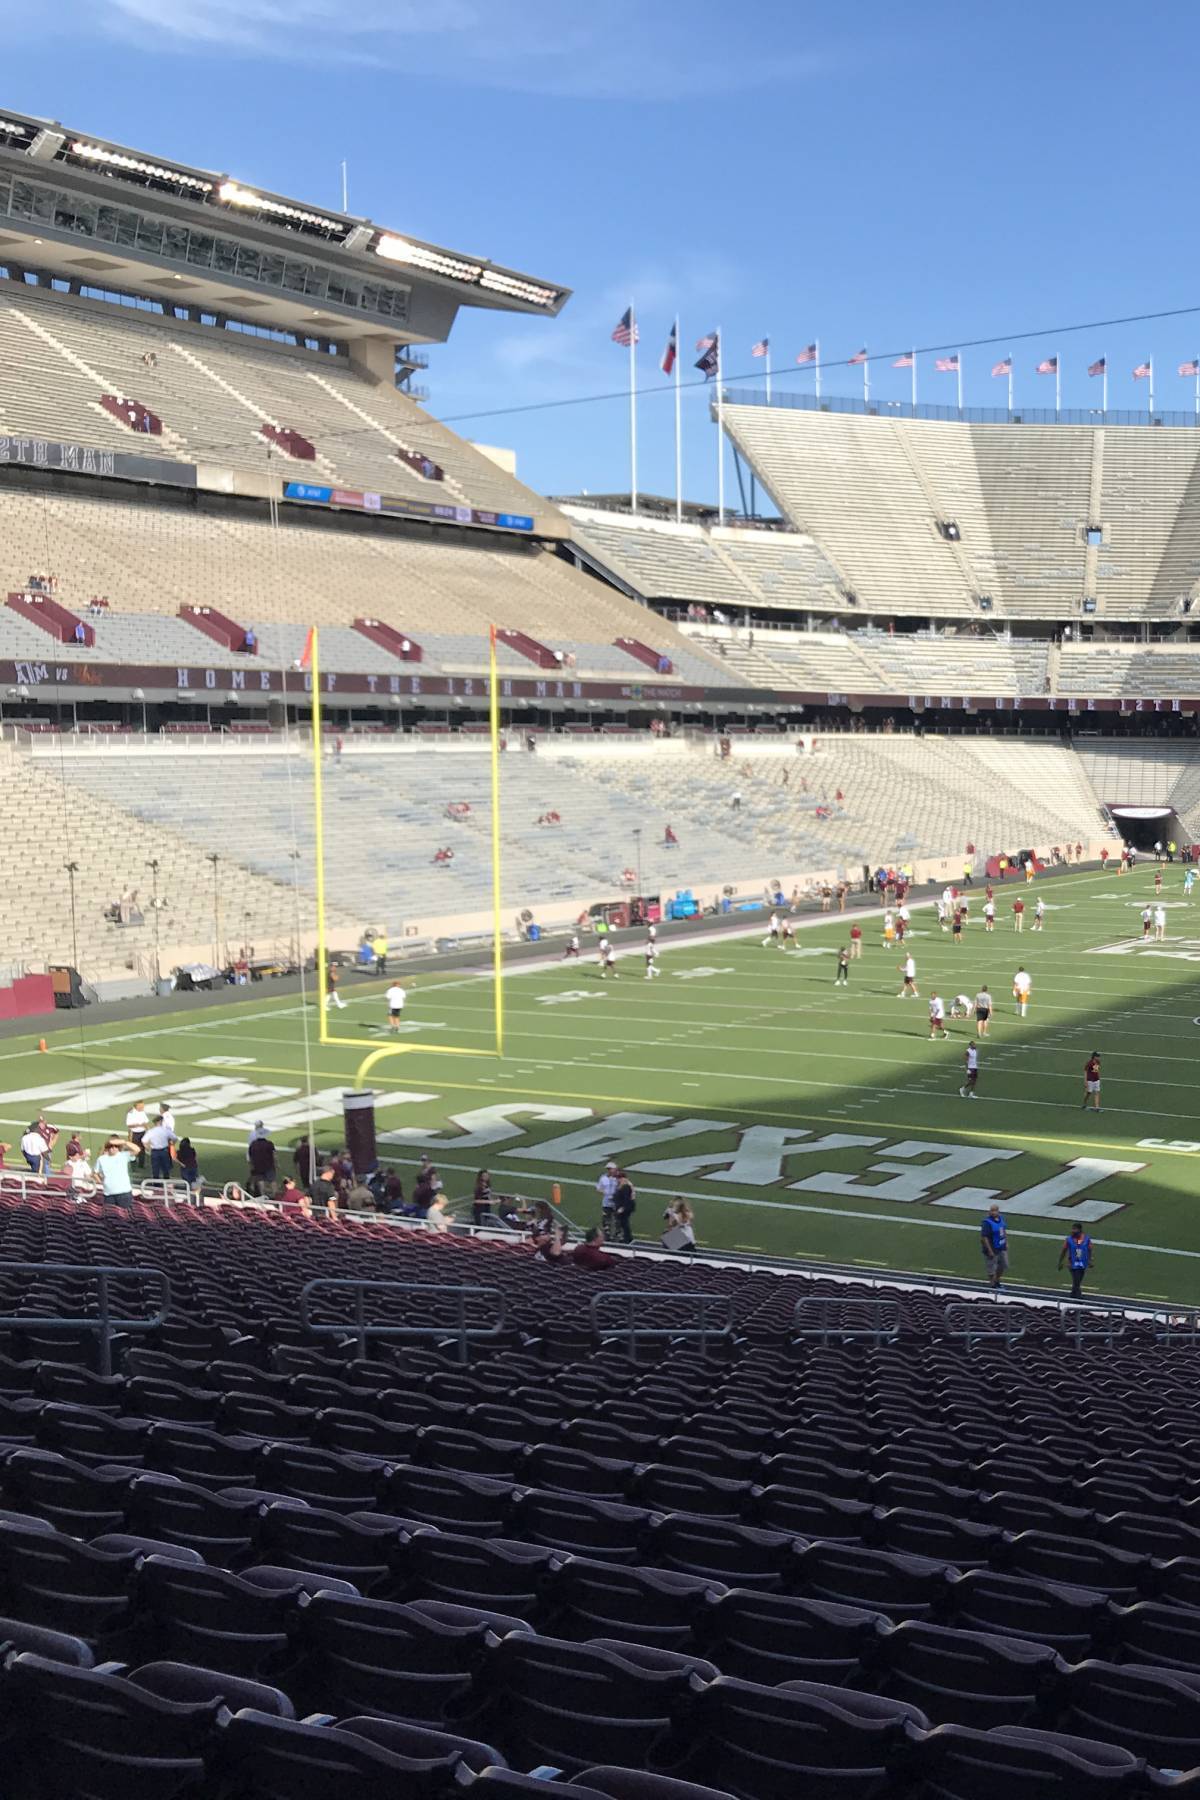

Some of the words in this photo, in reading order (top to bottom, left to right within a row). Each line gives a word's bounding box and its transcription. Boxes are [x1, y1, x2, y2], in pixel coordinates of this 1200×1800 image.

[60, 443, 114, 474] MAN
[177, 668, 271, 690] HOME
[367, 676, 420, 693] THE
[536, 681, 582, 698] MAN
[908, 696, 970, 709] HOME
[995, 698, 1021, 709] OF
[1048, 699, 1095, 711] THE
[1120, 699, 1180, 711] 12TH
